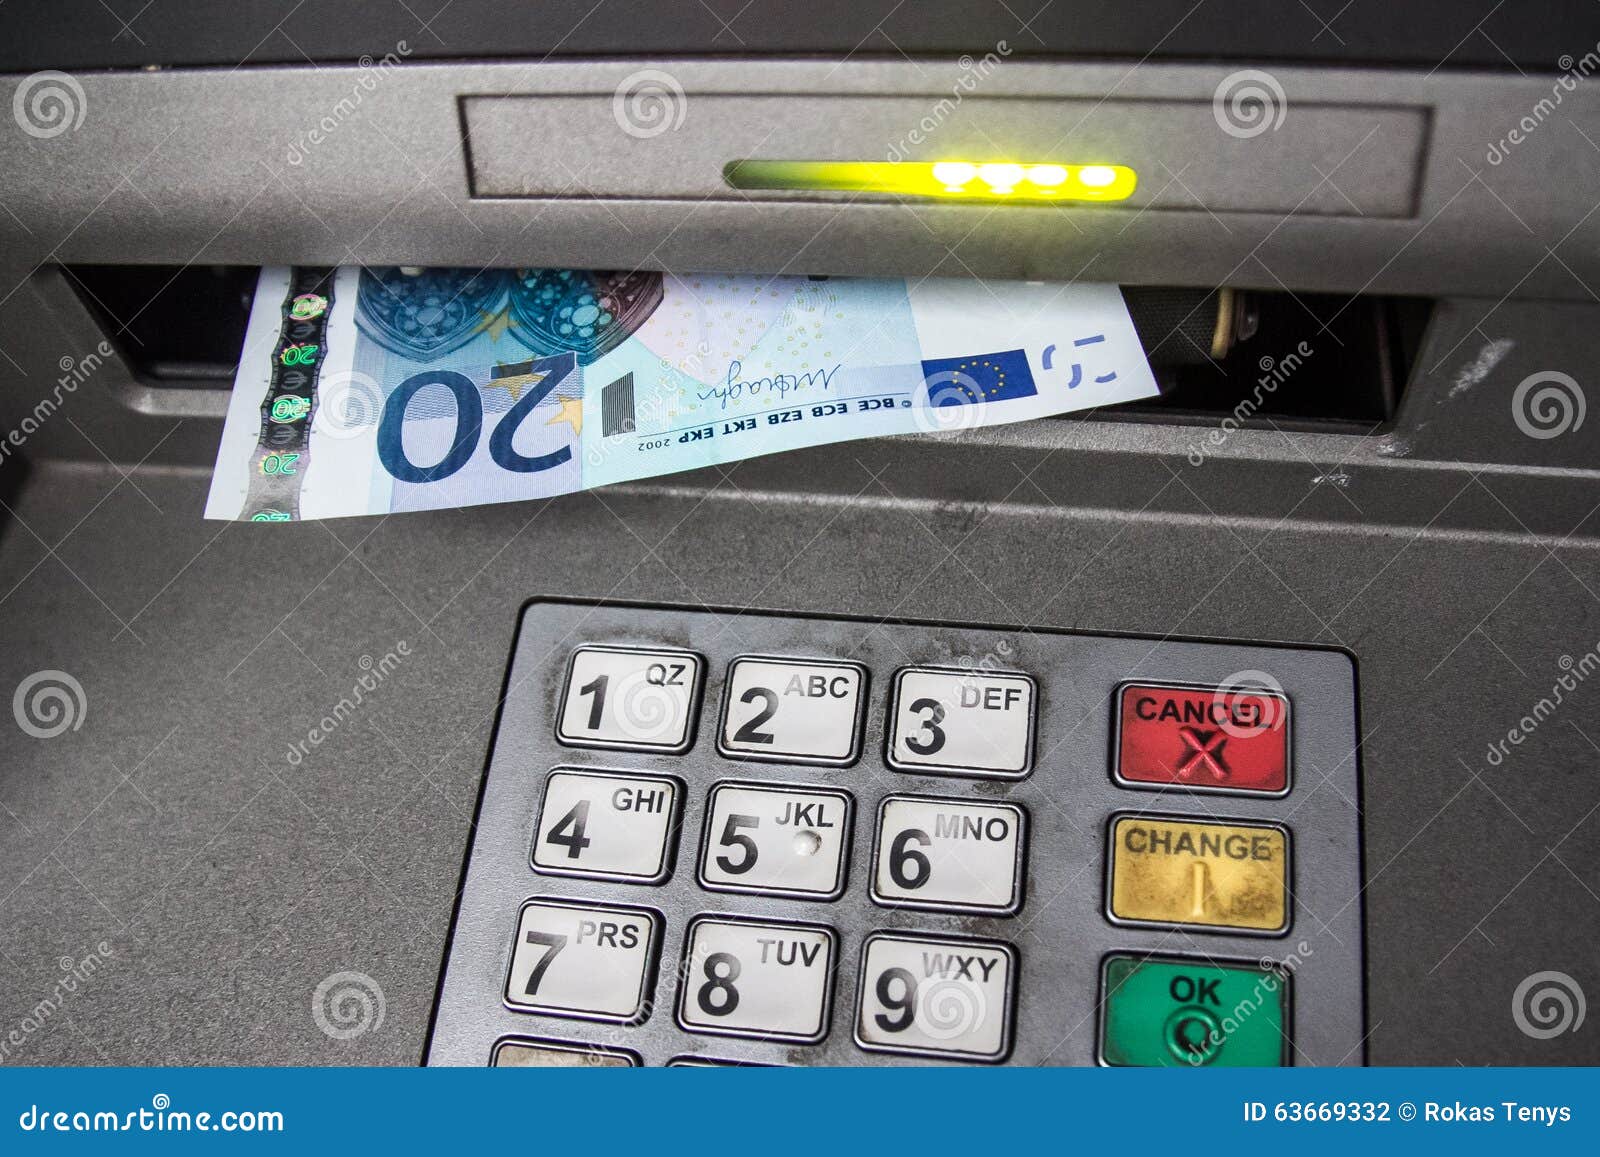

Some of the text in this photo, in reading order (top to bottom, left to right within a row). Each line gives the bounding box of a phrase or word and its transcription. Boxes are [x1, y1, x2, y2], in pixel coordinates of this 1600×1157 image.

[377, 351, 577, 483] 20
[722, 418, 757, 435] EKT
[768, 410, 803, 425] EZB
[812, 403, 848, 417] ECB
[858, 398, 894, 411] BCE
[638, 438, 670, 451] 2002
[678, 427, 714, 443] EKP
[263, 453, 299, 474] 20
[580, 664, 686, 730] 1 QZ
[733, 674, 849, 744] 2 ABC
[905, 686, 1022, 755] 3 DEF
[1135, 697, 1272, 728] CANCEL
[546, 788, 664, 859] 4 GHI
[716, 802, 833, 875] 5 JKL
[1124, 827, 1272, 861] CHANGE
[889, 814, 1009, 890] 6 MNO
[525, 920, 639, 995] 7 PRS
[697, 939, 821, 1016] 8 TUV
[874, 952, 998, 1032] 9 WXY
[1169, 975, 1221, 1006] OK
